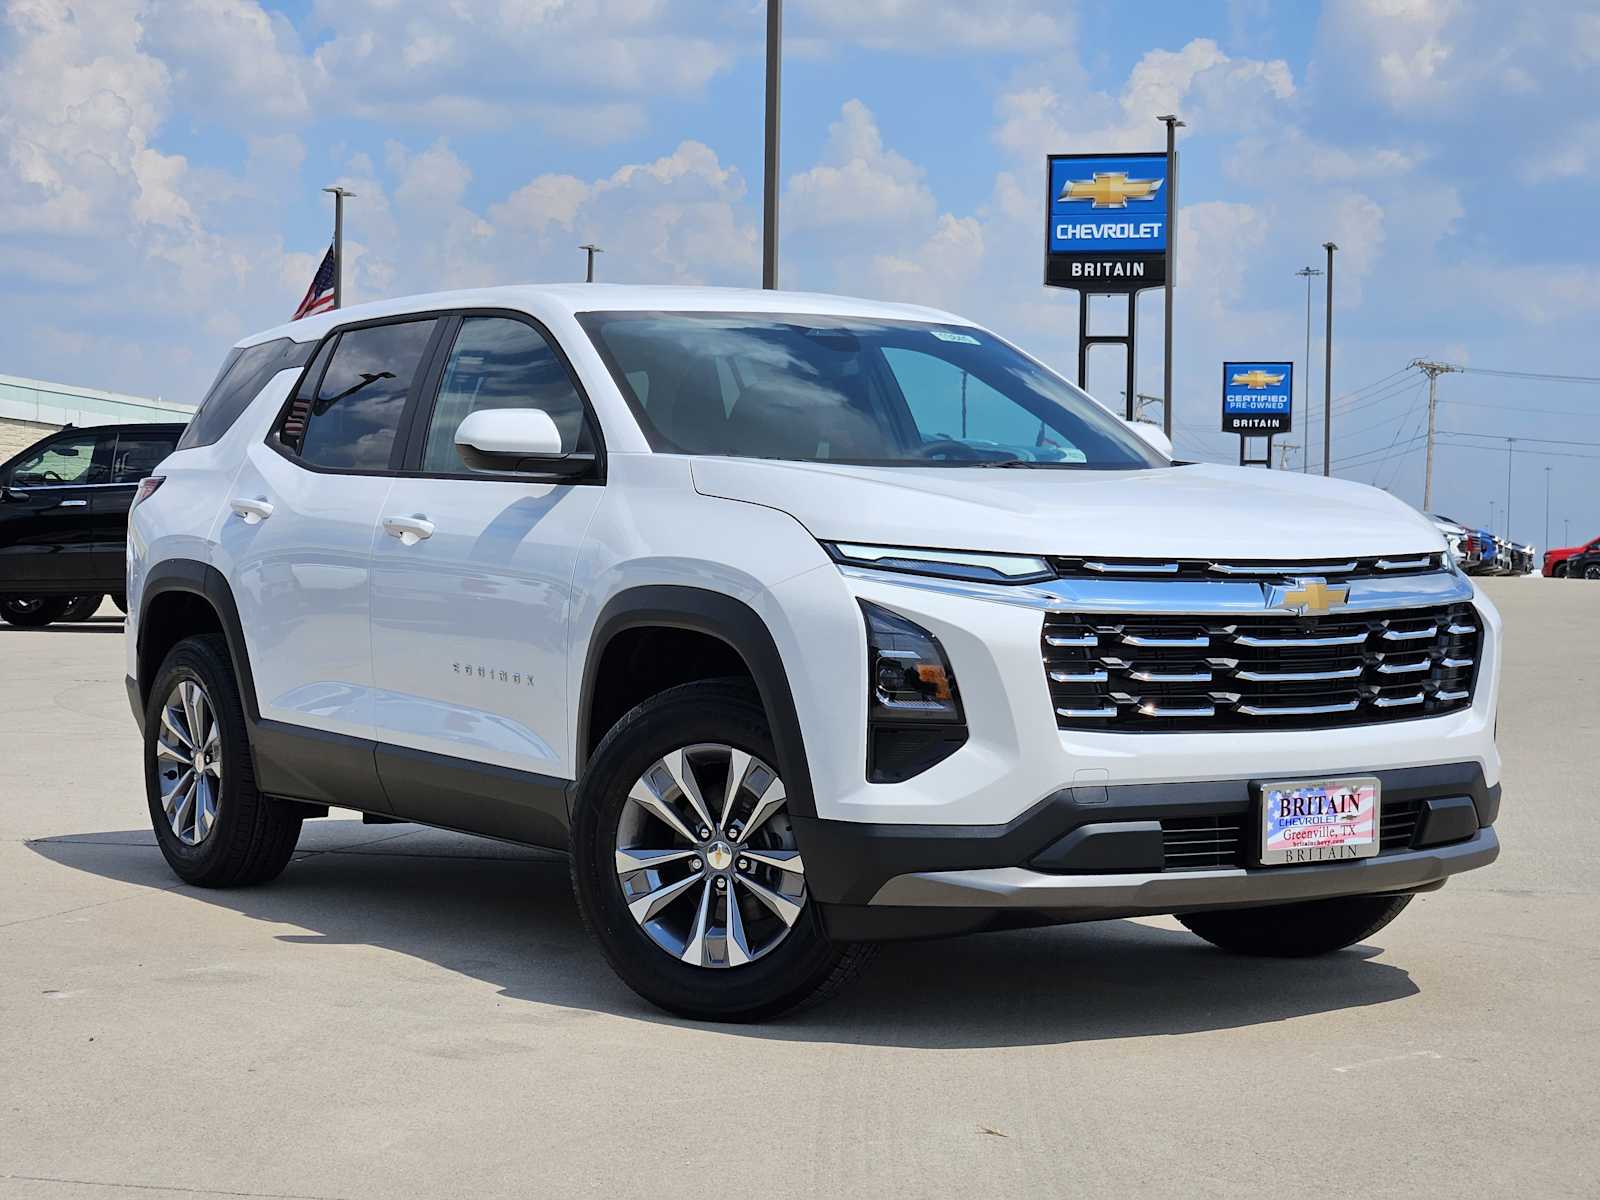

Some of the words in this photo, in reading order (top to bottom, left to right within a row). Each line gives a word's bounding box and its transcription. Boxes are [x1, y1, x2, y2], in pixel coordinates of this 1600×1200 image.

[1056, 223, 1163, 239] CHEVROLET
[1071, 262, 1145, 277] BRITAIN
[1233, 419, 1280, 428] BRITAIN
[1280, 794, 1360, 818] BRITAIN
[1279, 815, 1338, 827] CHEVROLET
[1283, 825, 1338, 840] Greenville,
[1342, 824, 1356, 836] TX
[1286, 845, 1358, 862] BRITAIN
